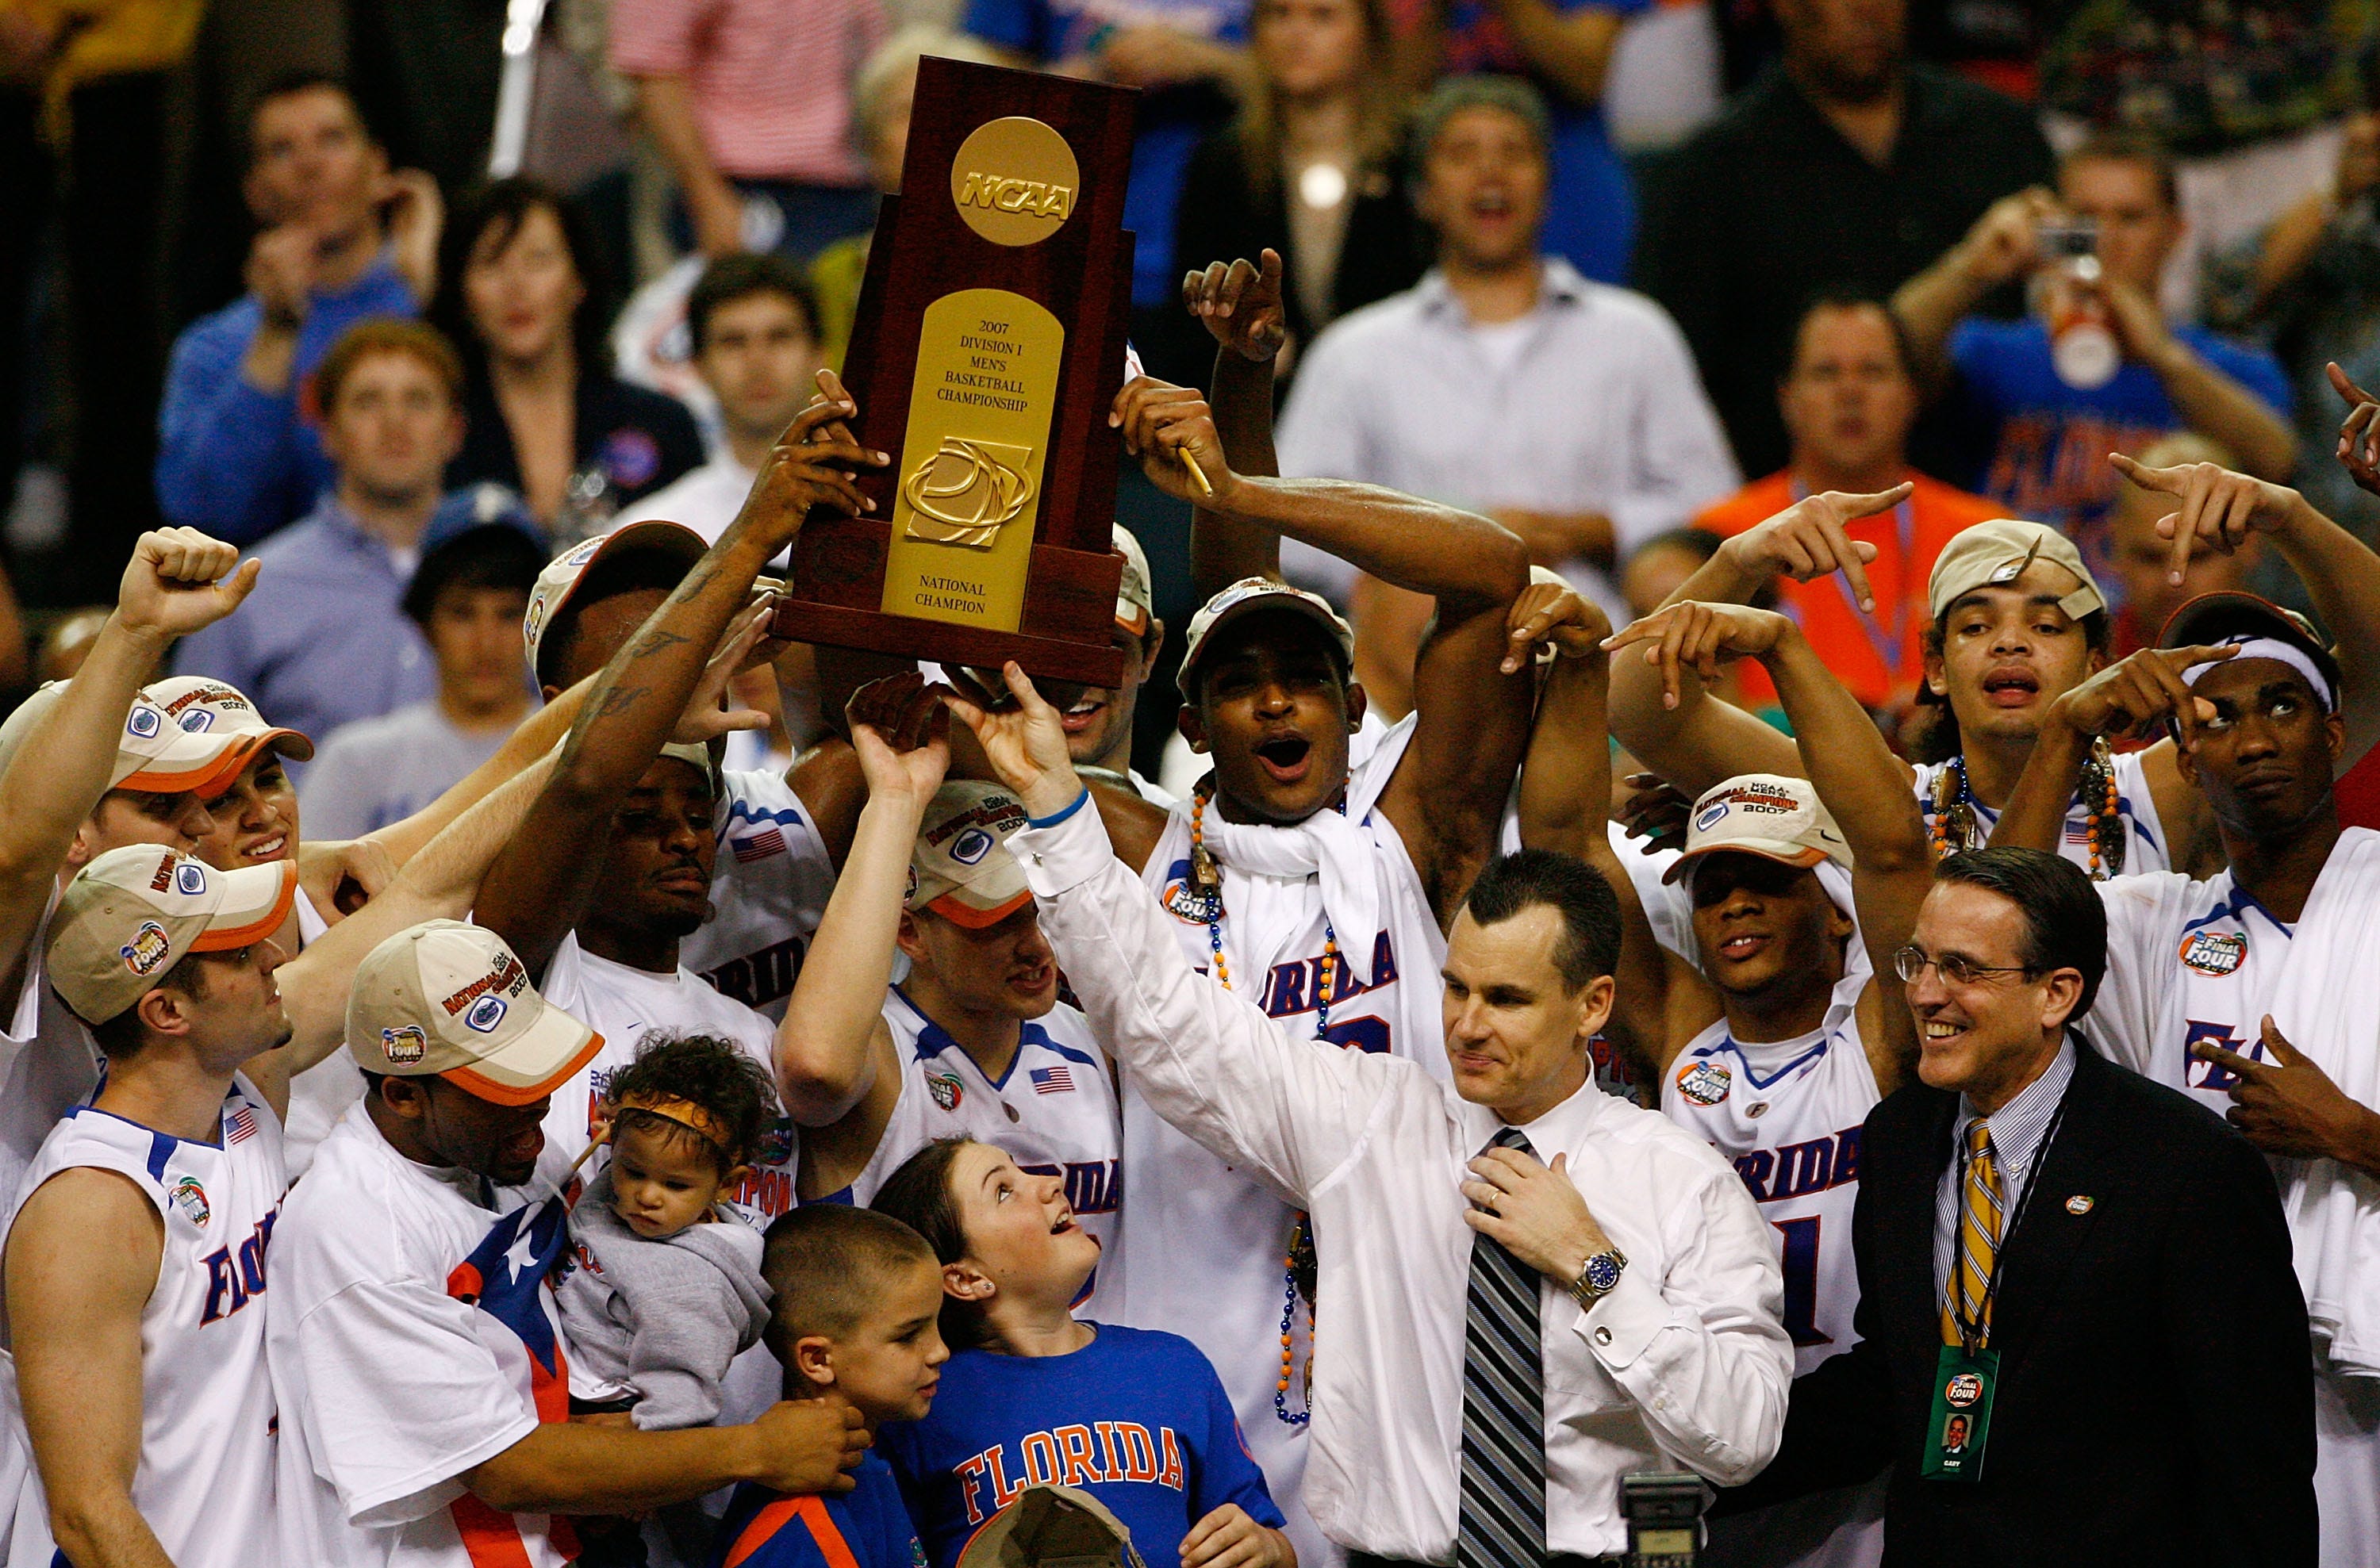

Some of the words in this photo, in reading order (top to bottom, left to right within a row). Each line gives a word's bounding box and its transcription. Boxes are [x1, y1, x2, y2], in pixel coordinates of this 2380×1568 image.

[960, 171, 1072, 220] NCAA
[978, 320, 1009, 335] 2007
[960, 335, 1014, 355] DIVISION
[1016, 344, 1023, 356] I
[970, 355, 1007, 372] MEN'S
[945, 370, 1025, 394] BASKETBALL
[937, 388, 1028, 412] CHAMPIONSHIP
[920, 574, 987, 596] NATIONAL
[915, 593, 985, 614] CHAMPION
[1729, 794, 1798, 811] CHAMPIONS
[1744, 804, 1787, 815] 2007
[2184, 941, 2238, 969] FOUR
[2205, 937, 2240, 955] FINAL
[441, 971, 501, 1016] NATIONAL
[509, 973, 528, 999] 2007
[389, 1043, 421, 1057] FOUR
[1771, 1214, 1834, 1347] 1
[1950, 1386, 1976, 1398] FOUR
[1959, 1380, 1976, 1389] FINAL
[952, 1421, 1184, 1526] FLORIDA
